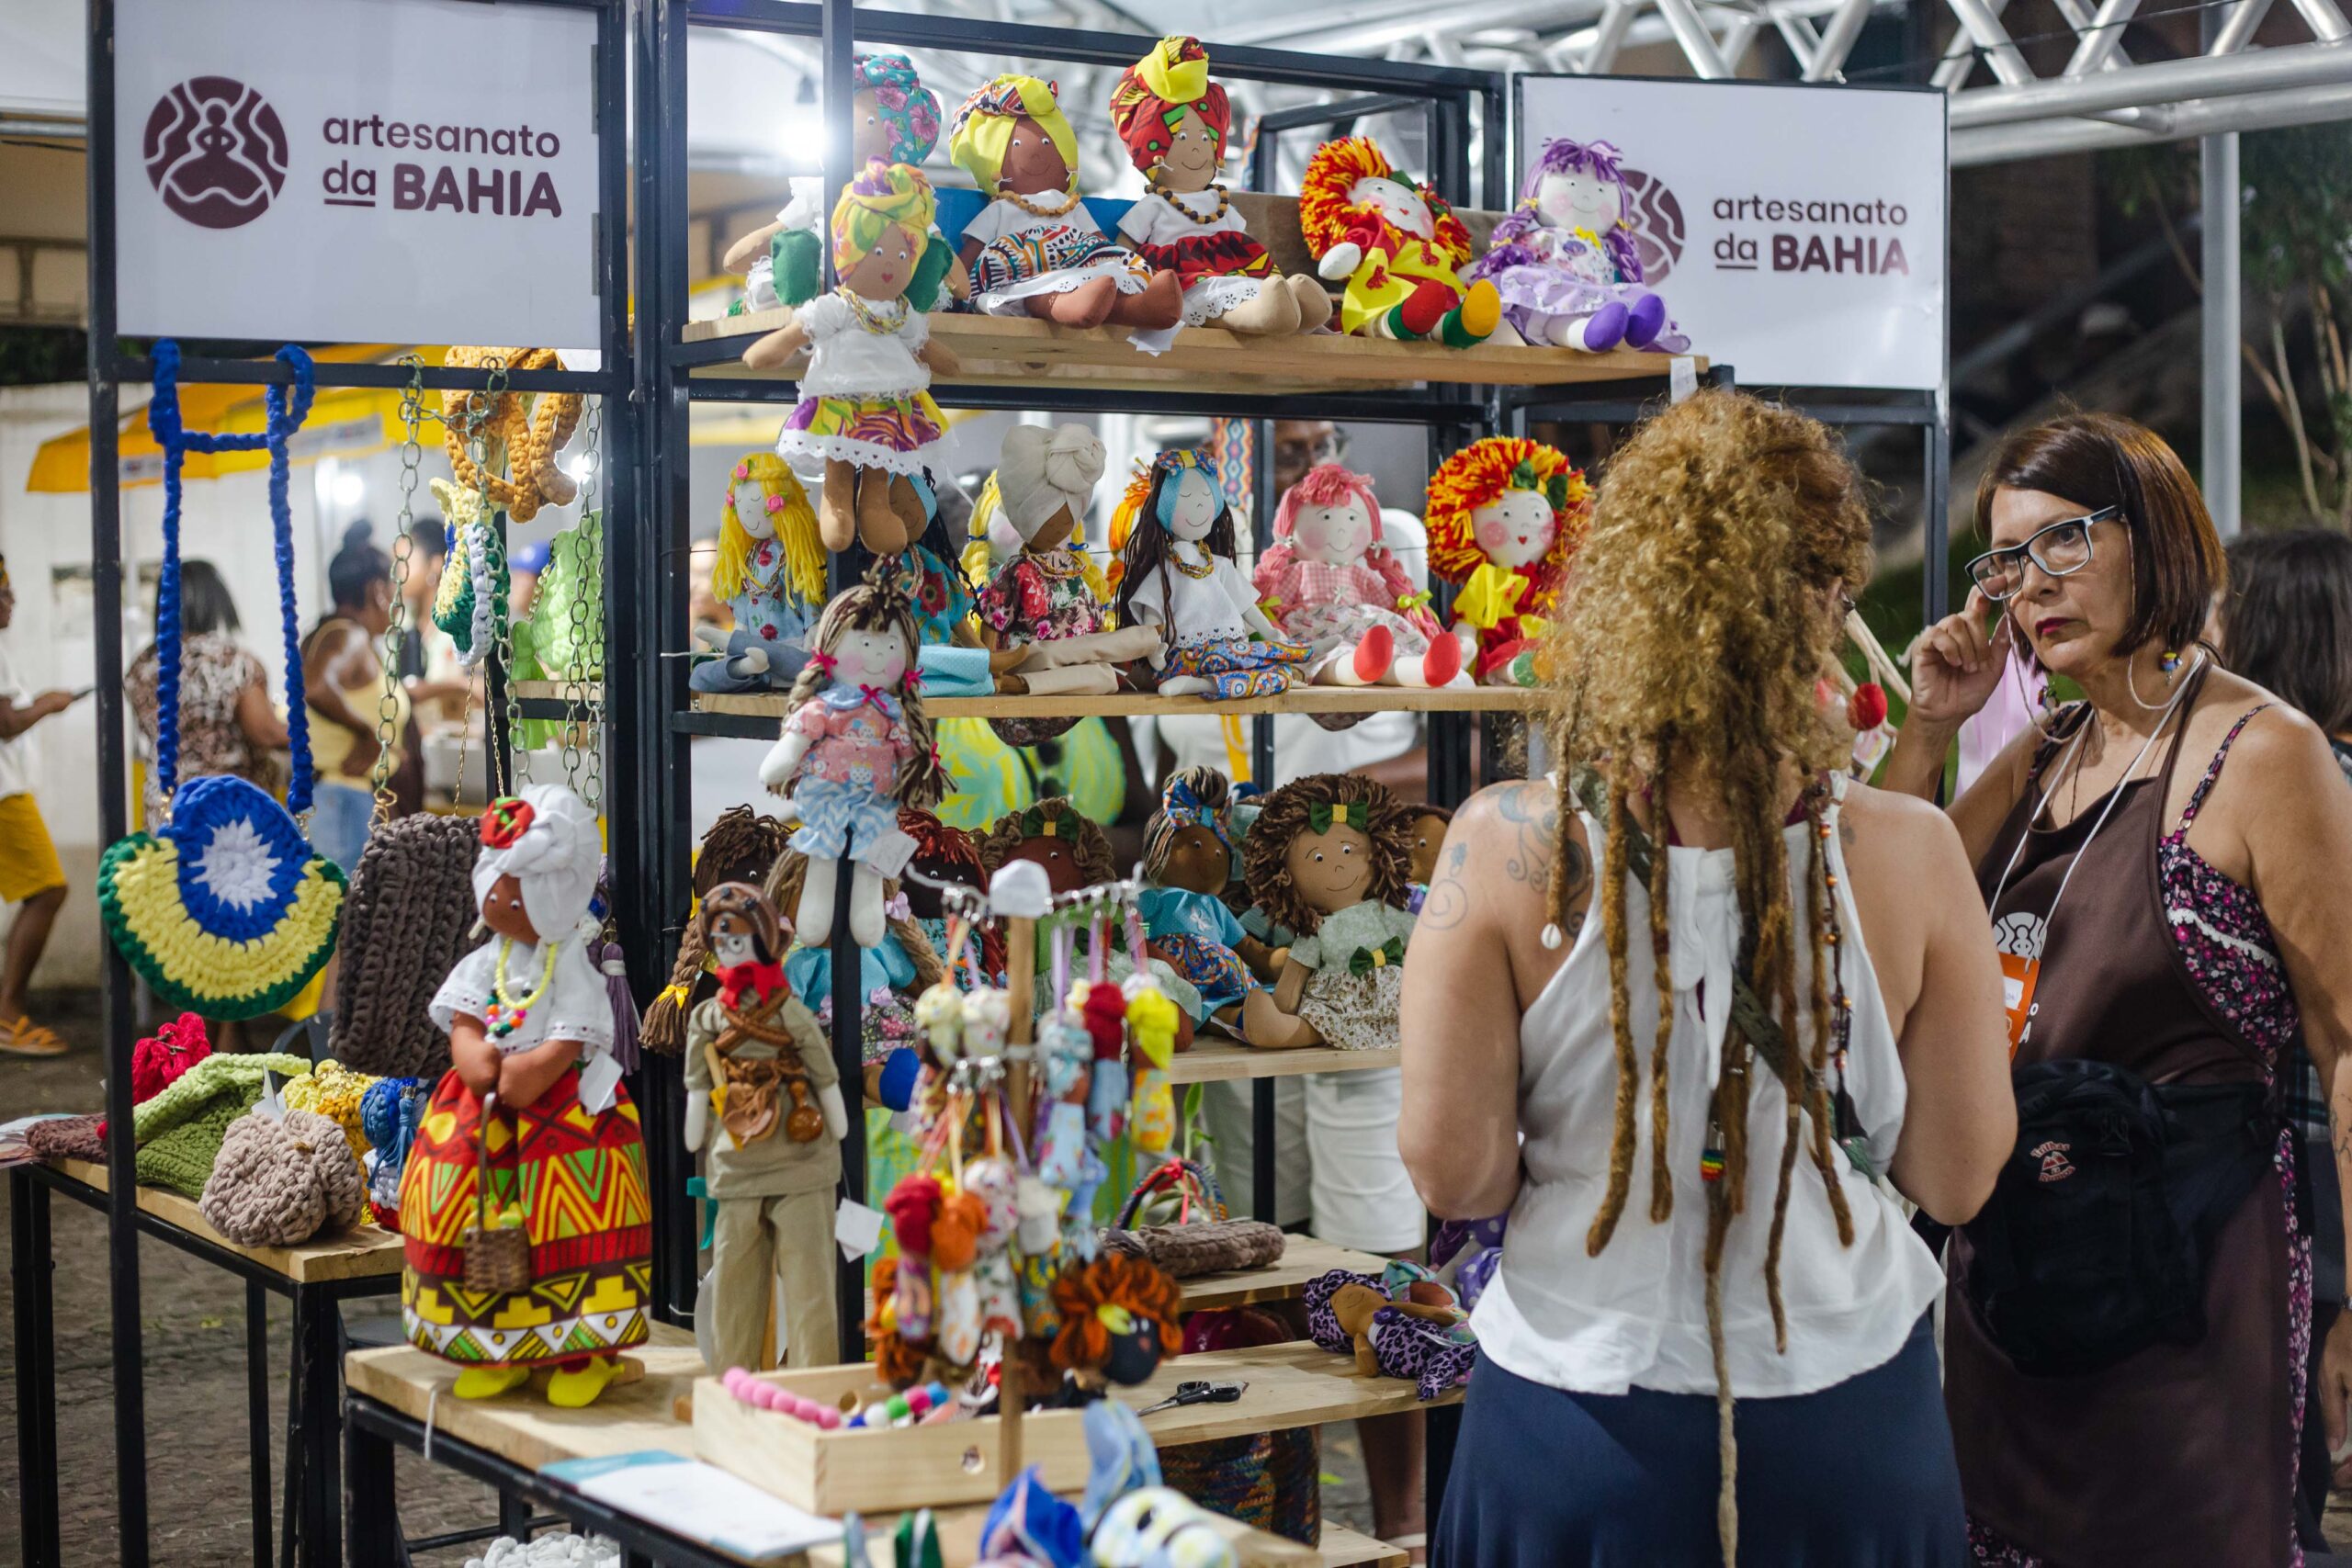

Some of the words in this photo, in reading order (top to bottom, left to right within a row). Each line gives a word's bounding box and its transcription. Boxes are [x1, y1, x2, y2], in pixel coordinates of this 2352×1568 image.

[322, 114, 560, 158] artesanato
[322, 160, 377, 197] da
[392, 163, 562, 219] BAHIA
[1713, 194, 1908, 226] artesanato
[1713, 232, 1758, 262] da
[1772, 233, 1910, 275] BAHIA
